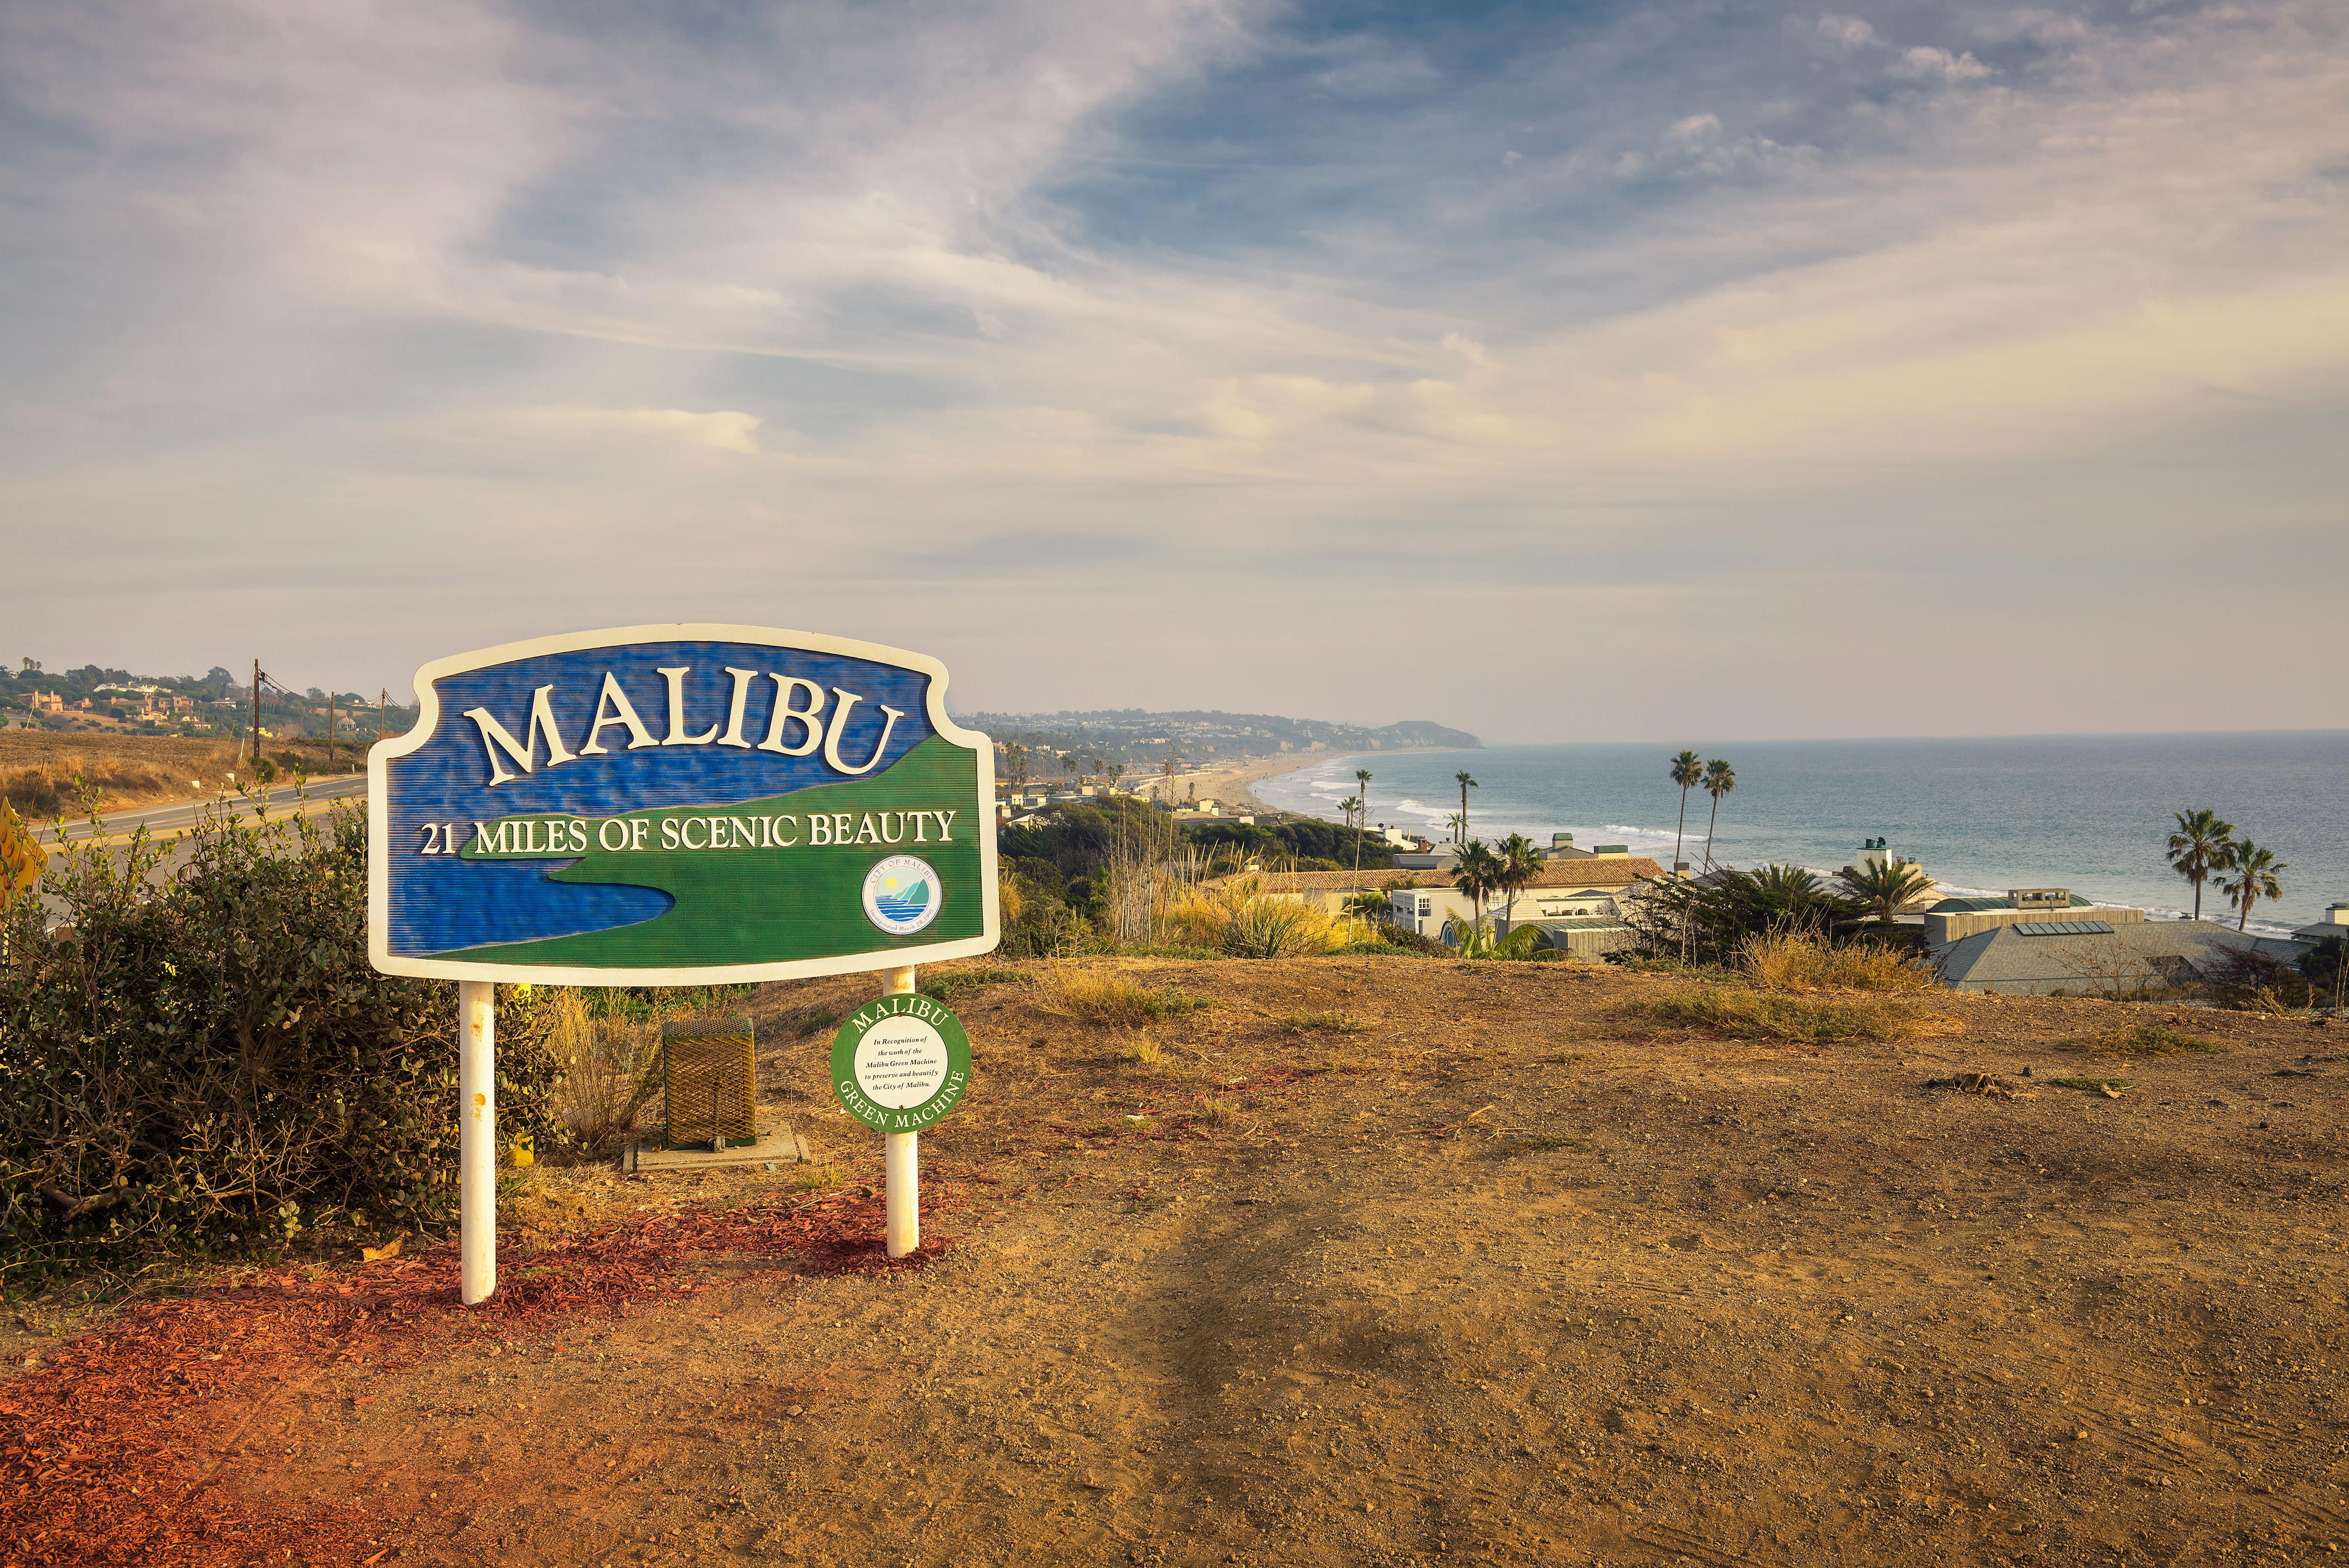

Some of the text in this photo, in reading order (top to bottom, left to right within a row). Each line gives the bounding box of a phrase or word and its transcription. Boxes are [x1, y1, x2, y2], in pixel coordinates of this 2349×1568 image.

[463, 666, 905, 786] MALIBU
[421, 810, 957, 855] 21 MILES OF SCENIC BEAUTY
[870, 864, 886, 883] CITY
[904, 859, 934, 881] MALIBU
[870, 909, 898, 930] Incorporated
[852, 998, 948, 1034] MALIBU
[882, 1037, 919, 1046] Recognition
[841, 1070, 965, 1128] GREEN MACHINE
